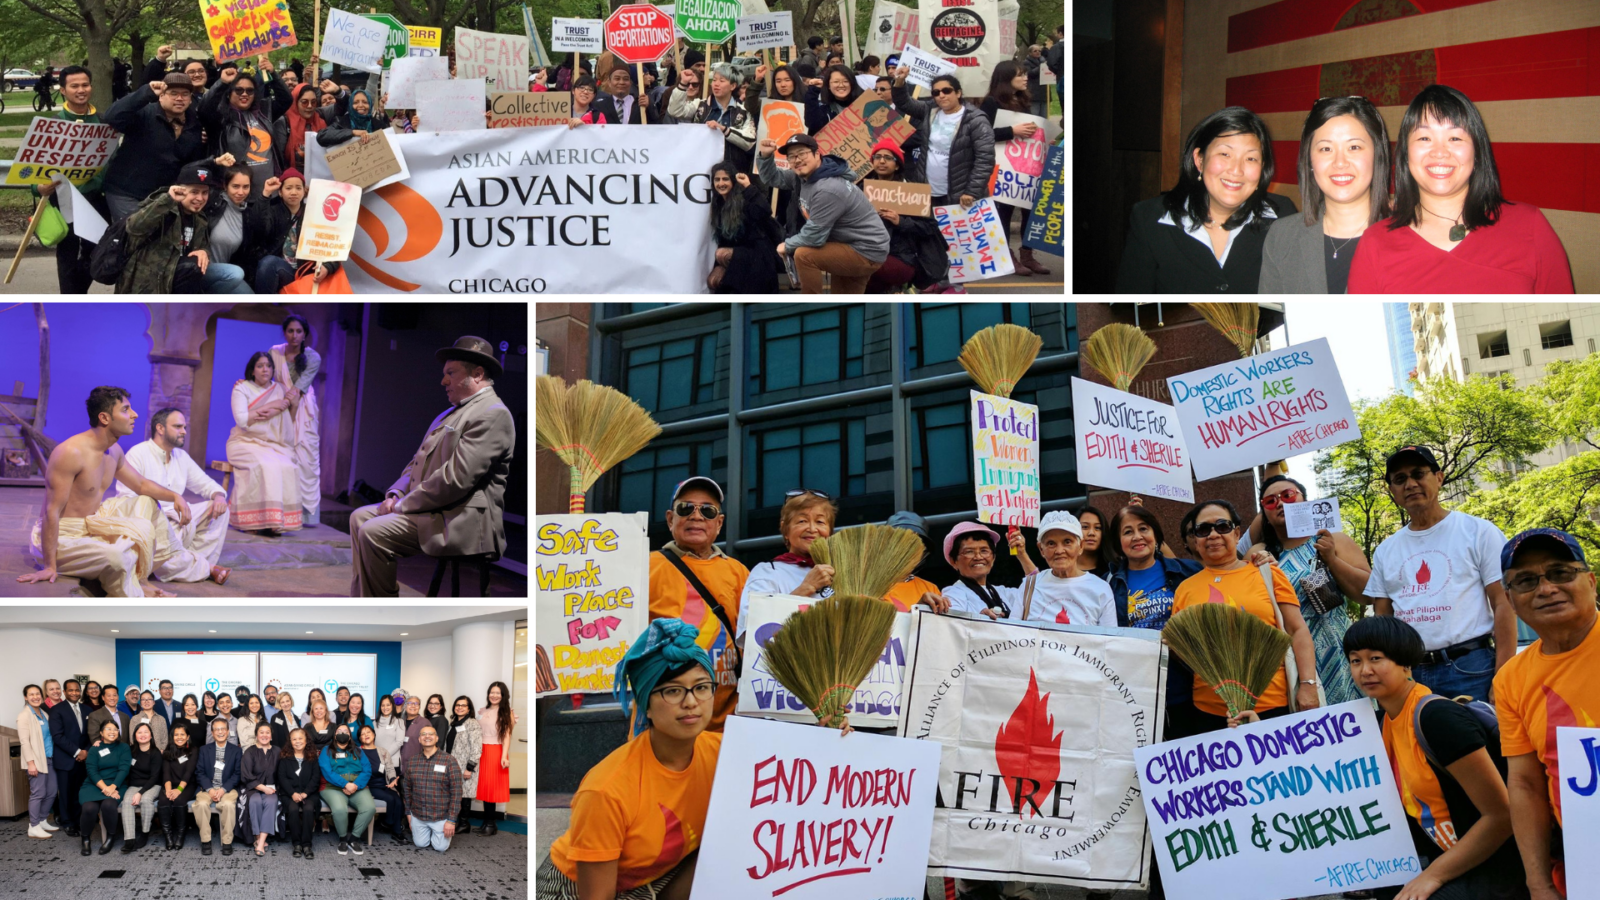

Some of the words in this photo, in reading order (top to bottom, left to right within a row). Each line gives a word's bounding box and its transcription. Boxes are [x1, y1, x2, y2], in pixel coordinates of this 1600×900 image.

[619, 11, 657, 28] STOP
[678, 0, 739, 20] LEGALIZACION
[332, 10, 355, 33] We
[359, 27, 380, 42] are
[408, 29, 436, 40] CIRR
[564, 26, 590, 35] TRUST
[610, 27, 671, 48] DEPORTATIONS
[685, 18, 730, 33] AHORA
[749, 21, 777, 31] TRUST
[750, 31, 784, 40] WELCOMING
[935, 25, 984, 38] REIMAGINE.
[342, 35, 361, 49] all
[457, 32, 526, 66] SPEAK
[911, 67, 936, 79] WELCOM
[914, 56, 941, 74] TRUST
[941, 56, 980, 67] BUILD.
[464, 64, 488, 79] UP
[496, 69, 525, 91] ALL
[492, 94, 568, 115] Collective
[34, 119, 118, 139] RESISTANCE
[27, 134, 92, 152] UNITY
[95, 140, 107, 153] &
[1008, 138, 1047, 164] STOP
[19, 148, 108, 167] RESPECT
[448, 150, 512, 169] ASIAN
[519, 148, 650, 166] AMERICANS
[35, 166, 96, 179] ICIRR
[444, 173, 712, 208] ADVANCING
[865, 185, 931, 216] Sanctuary
[1034, 179, 1056, 216] POWER
[448, 214, 612, 258] JUSTICE
[934, 207, 958, 250] STAND
[1027, 221, 1045, 242] THE
[1043, 201, 1064, 245] PEOPLE
[953, 219, 974, 254] WITH
[950, 258, 965, 278] WE
[448, 277, 547, 294] CHICAGO
[1171, 372, 1238, 403] DOMESTIC
[1236, 351, 1314, 382] WORKERS
[1202, 387, 1255, 418] RIGHTS
[1262, 376, 1297, 401] ARE
[977, 400, 1037, 442] Protect
[1089, 396, 1145, 432] JUSTICE
[1146, 410, 1174, 438] FOR
[1197, 405, 1266, 449] HUMAN
[1264, 388, 1328, 427] RIGHTS
[1315, 417, 1350, 442] CHICAGO
[991, 434, 1035, 464] Women,
[1084, 431, 1128, 463] EDITH
[1131, 443, 1138, 457] &
[1139, 439, 1184, 468] SHERILE
[981, 489, 1003, 507] and
[990, 508, 1006, 525] of
[1009, 510, 1035, 527] color
[536, 519, 619, 556] Safe
[536, 559, 602, 592] Work
[564, 586, 635, 617] Place
[1127, 604, 1166, 620] PILIPINX!
[1416, 605, 1452, 614] Pilipino
[567, 615, 622, 645] For
[1401, 614, 1441, 623] ahalaga
[967, 638, 1036, 666] FILIPINOS
[1040, 640, 1067, 653] FOR
[557, 668, 631, 693] Worke
[950, 662, 967, 680] OF
[1071, 644, 1137, 706] IMMIGRANT
[916, 678, 952, 740] ALLIANCE
[1131, 709, 1147, 748] RIGH
[1145, 739, 1243, 785] CHICAGO
[1244, 711, 1362, 766] DOMESTIC
[749, 754, 817, 809] END
[822, 764, 917, 809] MODERN
[1151, 779, 1248, 824] WORKERS
[1245, 765, 1313, 805] STAND
[1310, 755, 1381, 795] WITH
[968, 816, 1067, 840] Chicago
[1052, 785, 1142, 861] EMPOWERMENT
[1164, 818, 1239, 873] EDITH
[1250, 812, 1272, 853] &
[1272, 799, 1391, 853] SHERILE
[746, 815, 894, 880] SLAVERY!
[1365, 855, 1420, 881] CHICAGO
